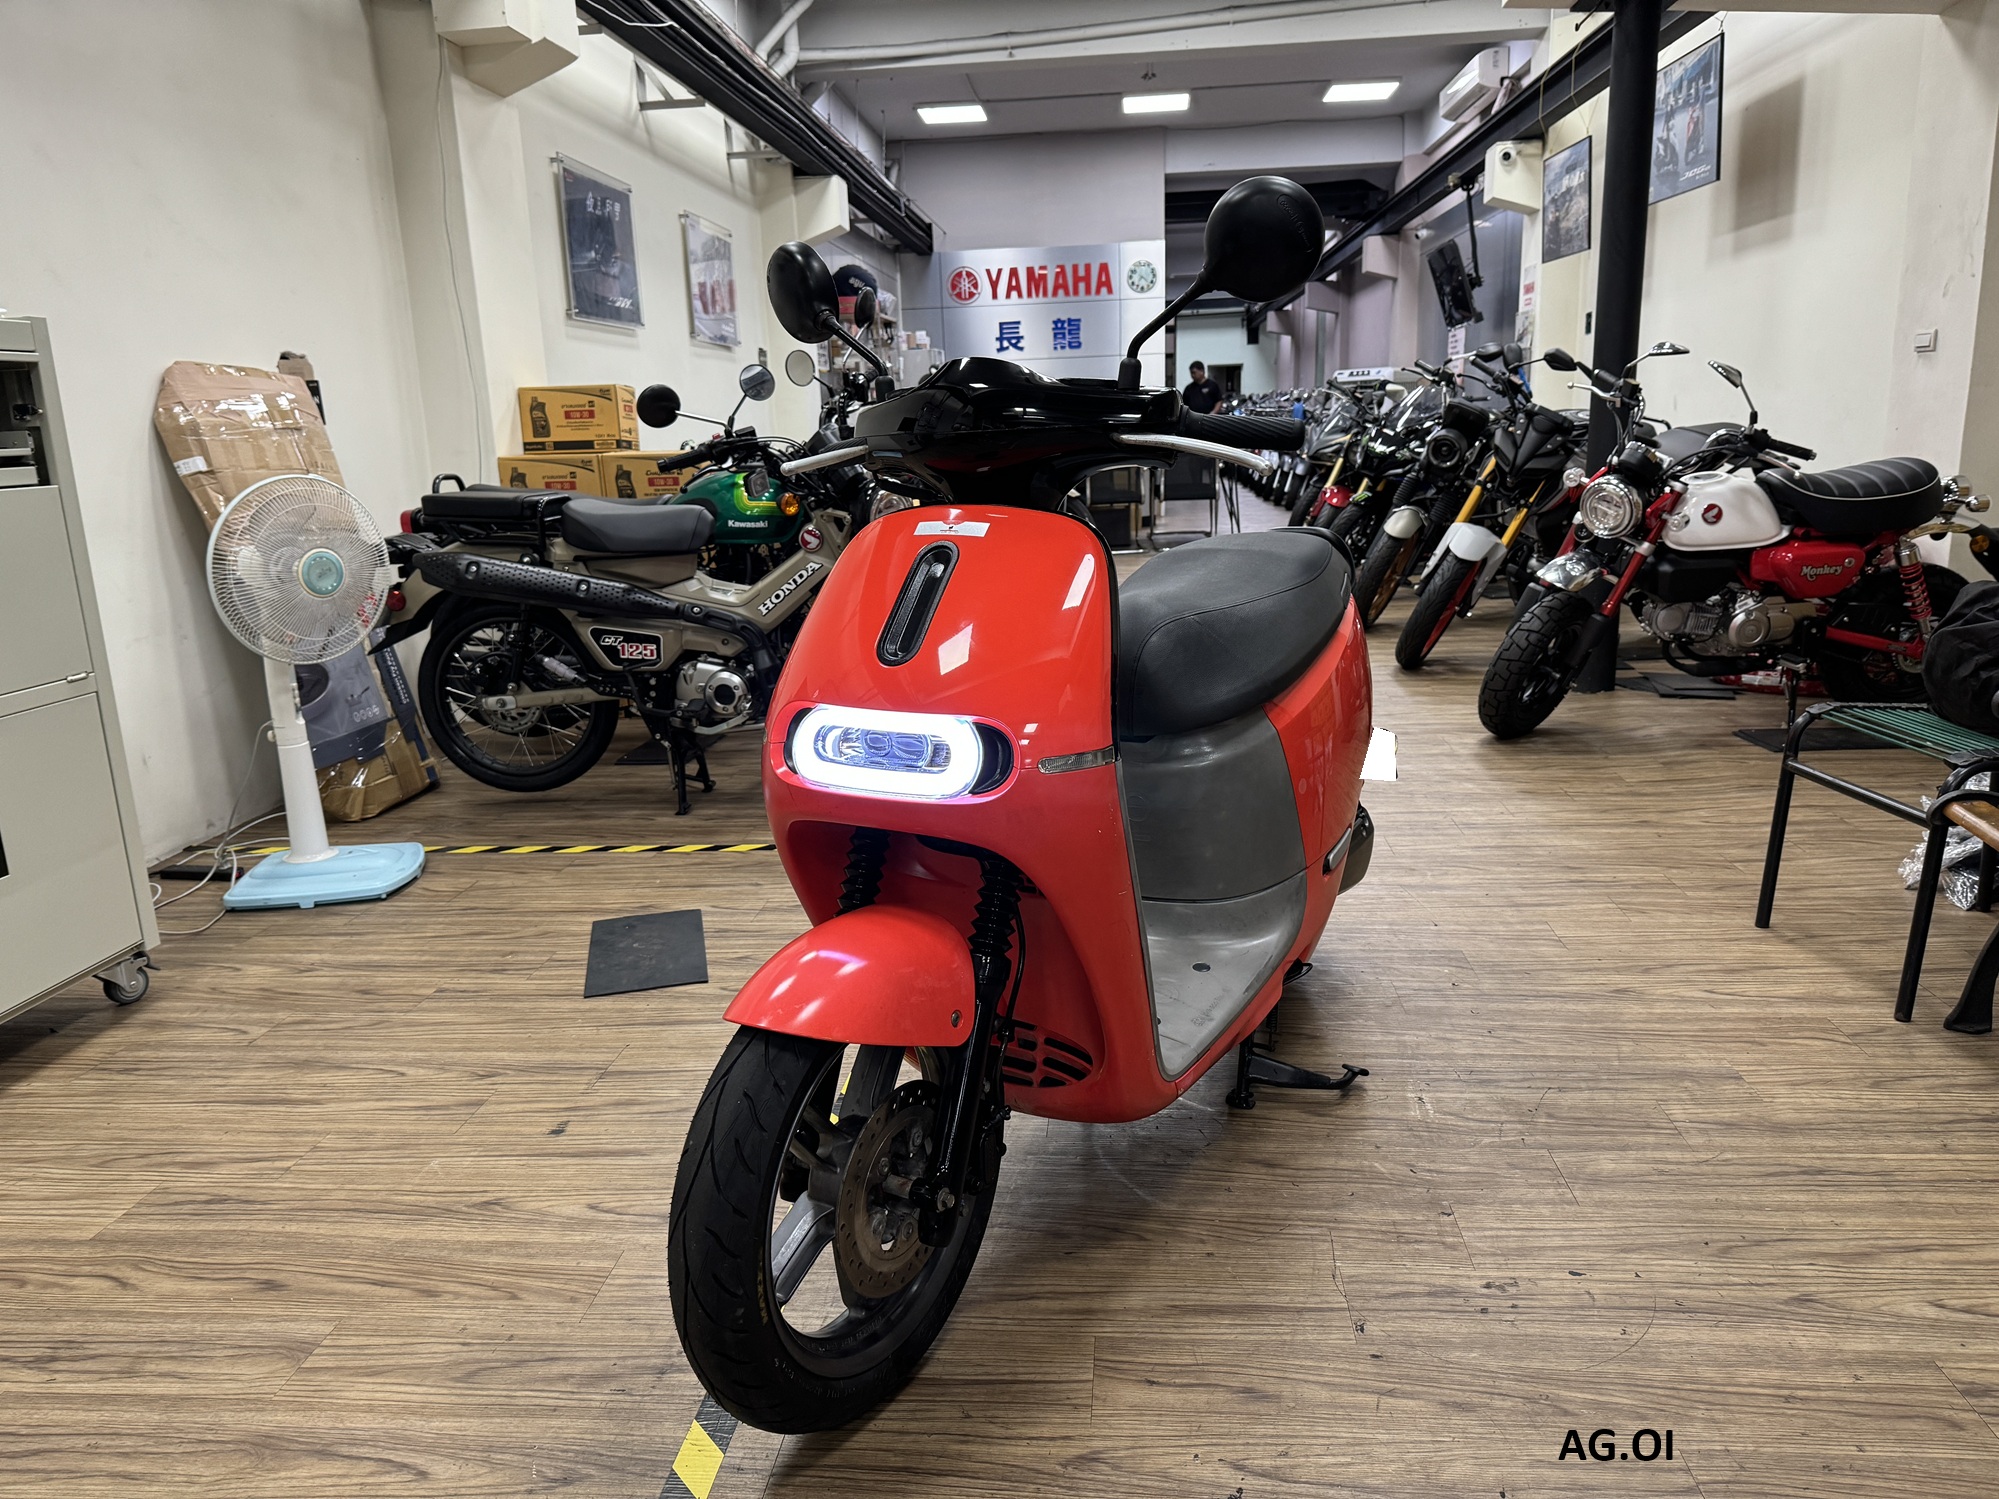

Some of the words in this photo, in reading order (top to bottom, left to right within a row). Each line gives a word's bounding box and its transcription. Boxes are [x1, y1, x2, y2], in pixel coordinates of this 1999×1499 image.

[985, 262, 1114, 300] YAMAHA
[995, 317, 1082, 354] 長龍
[728, 519, 768, 528] Kawasaki
[757, 561, 823, 616] HONDA
[1801, 565, 1843, 581] Monkey
[600, 635, 623, 646] CT
[617, 642, 657, 660] 125
